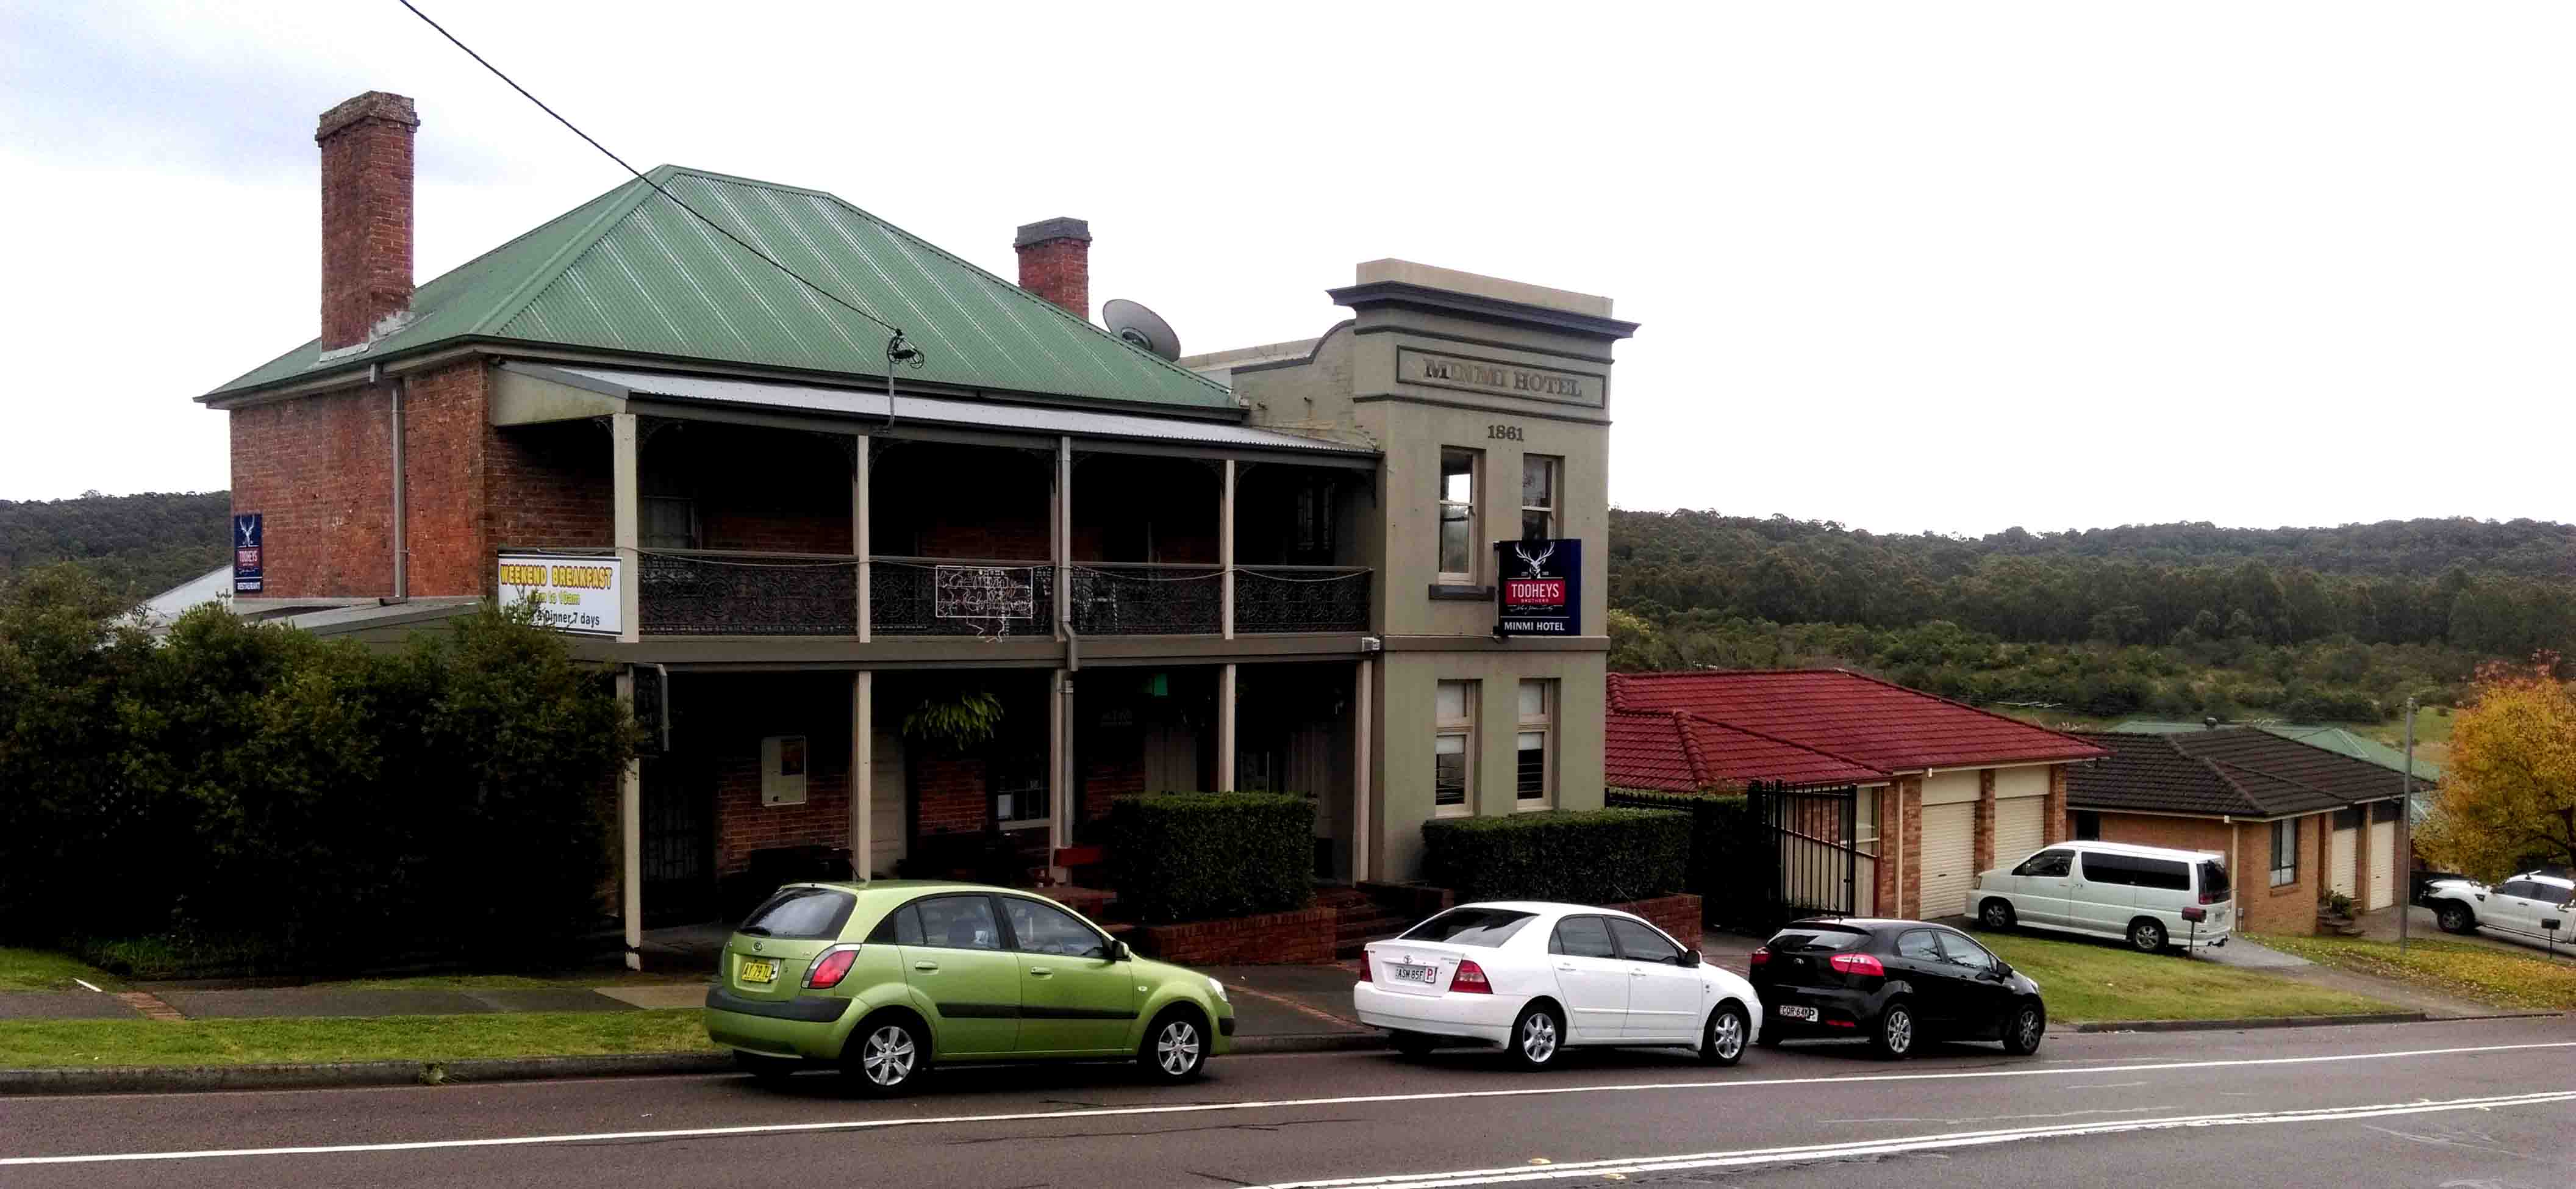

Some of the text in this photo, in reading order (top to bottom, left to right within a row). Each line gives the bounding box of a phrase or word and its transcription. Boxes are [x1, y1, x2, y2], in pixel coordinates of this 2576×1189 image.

[1423, 359, 1583, 397] MINMI HOTEL
[1487, 425, 1524, 442] 1861
[500, 563, 612, 590] WEEKEND BREAKFAST
[1511, 583, 1559, 598] TOOHEYS
[581, 612, 600, 628] days
[1504, 622, 1565, 631] MINMI HOTEL
[1426, 968, 1433, 980] P
